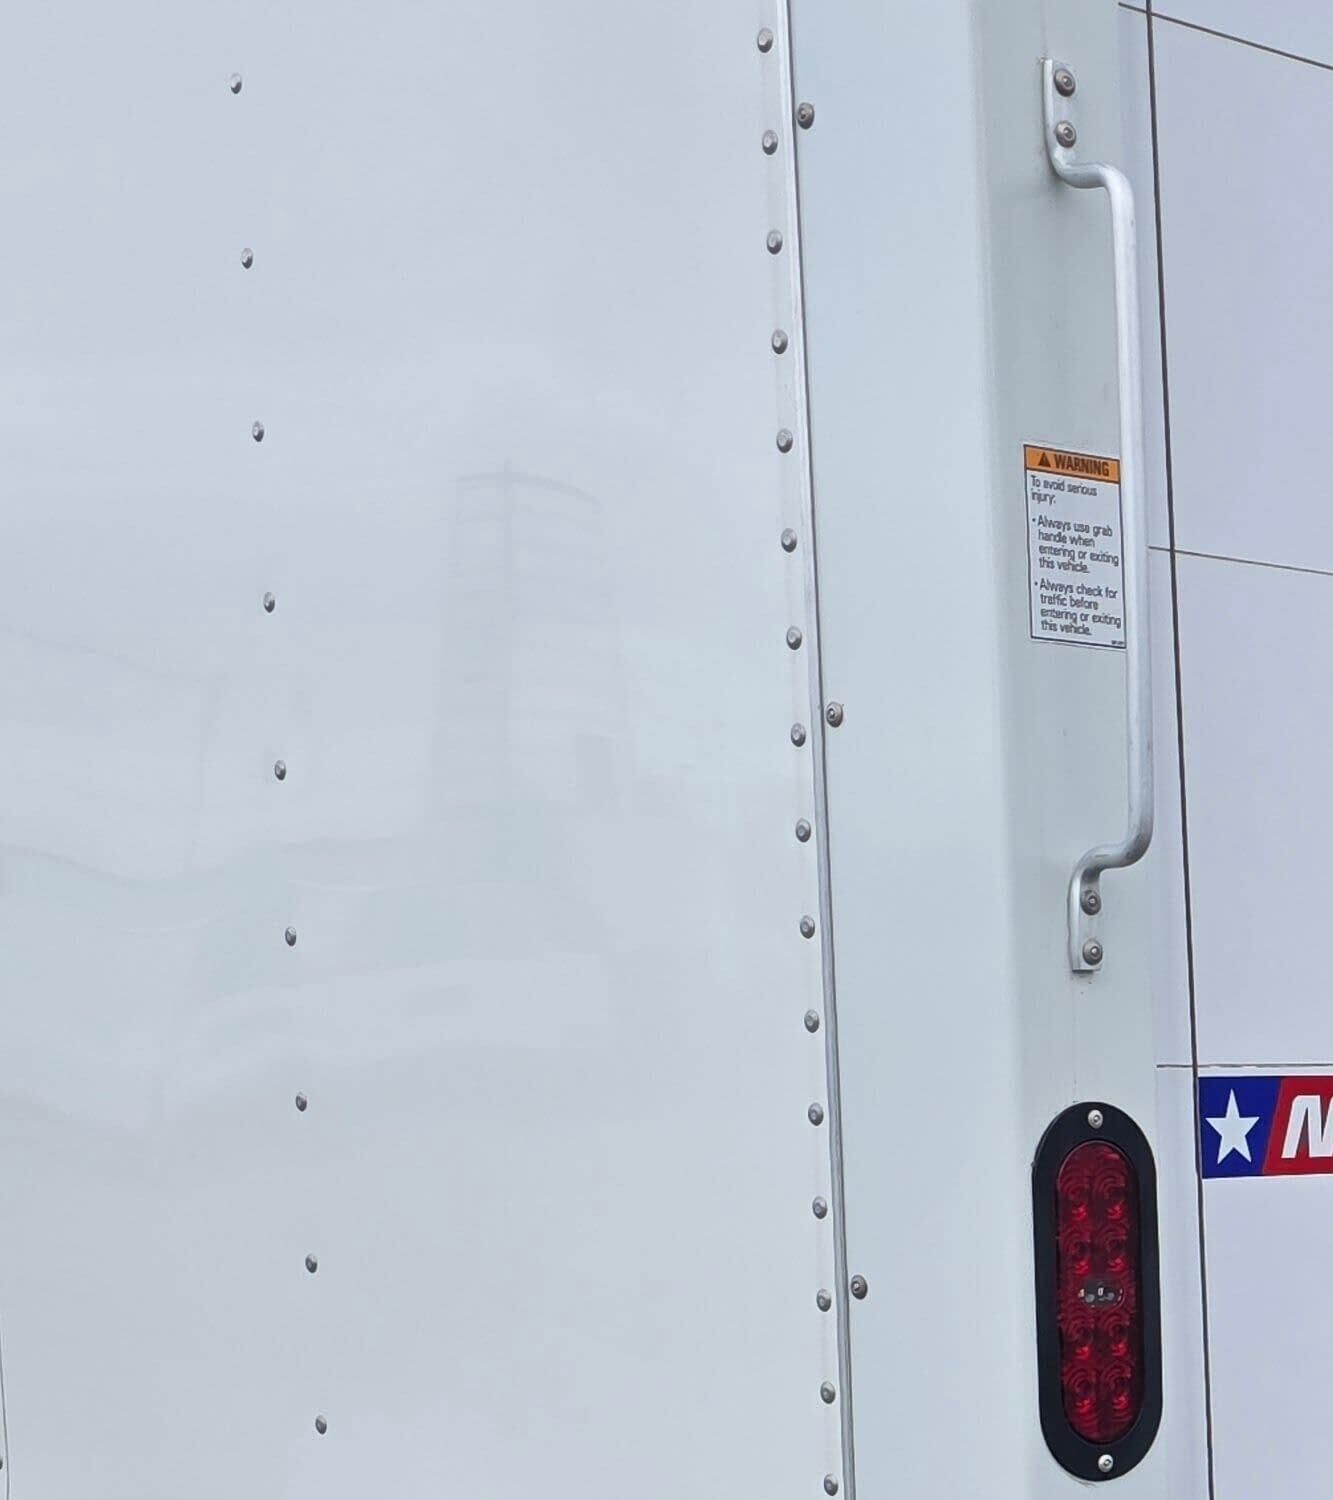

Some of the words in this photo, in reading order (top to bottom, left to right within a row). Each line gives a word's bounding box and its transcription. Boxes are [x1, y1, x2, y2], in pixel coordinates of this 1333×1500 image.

[1054, 454, 1110, 476] WARNING
[1030, 474, 1041, 488] To
[1043, 479, 1065, 492] avoid
[1067, 483, 1098, 496] serious
[1038, 514, 1071, 532] Always
[1073, 523, 1090, 534] use
[1093, 525, 1113, 537] grab
[1038, 529, 1067, 544] handle
[1069, 535, 1095, 547] when
[1039, 545, 1075, 562] entering
[1078, 550, 1088, 560] or
[1090, 551, 1119, 567] exiting
[1039, 556, 1055, 569] this
[1040, 578, 1074, 595] Always
[1076, 583, 1103, 597] check
[1105, 587, 1118, 599] for
[1040, 593, 1068, 606] traffic
[1069, 596, 1099, 610] before
[1040, 608, 1078, 625] entering
[1079, 613, 1090, 622] or
[1092, 612, 1121, 629] exiting
[1041, 619, 1058, 632] this
